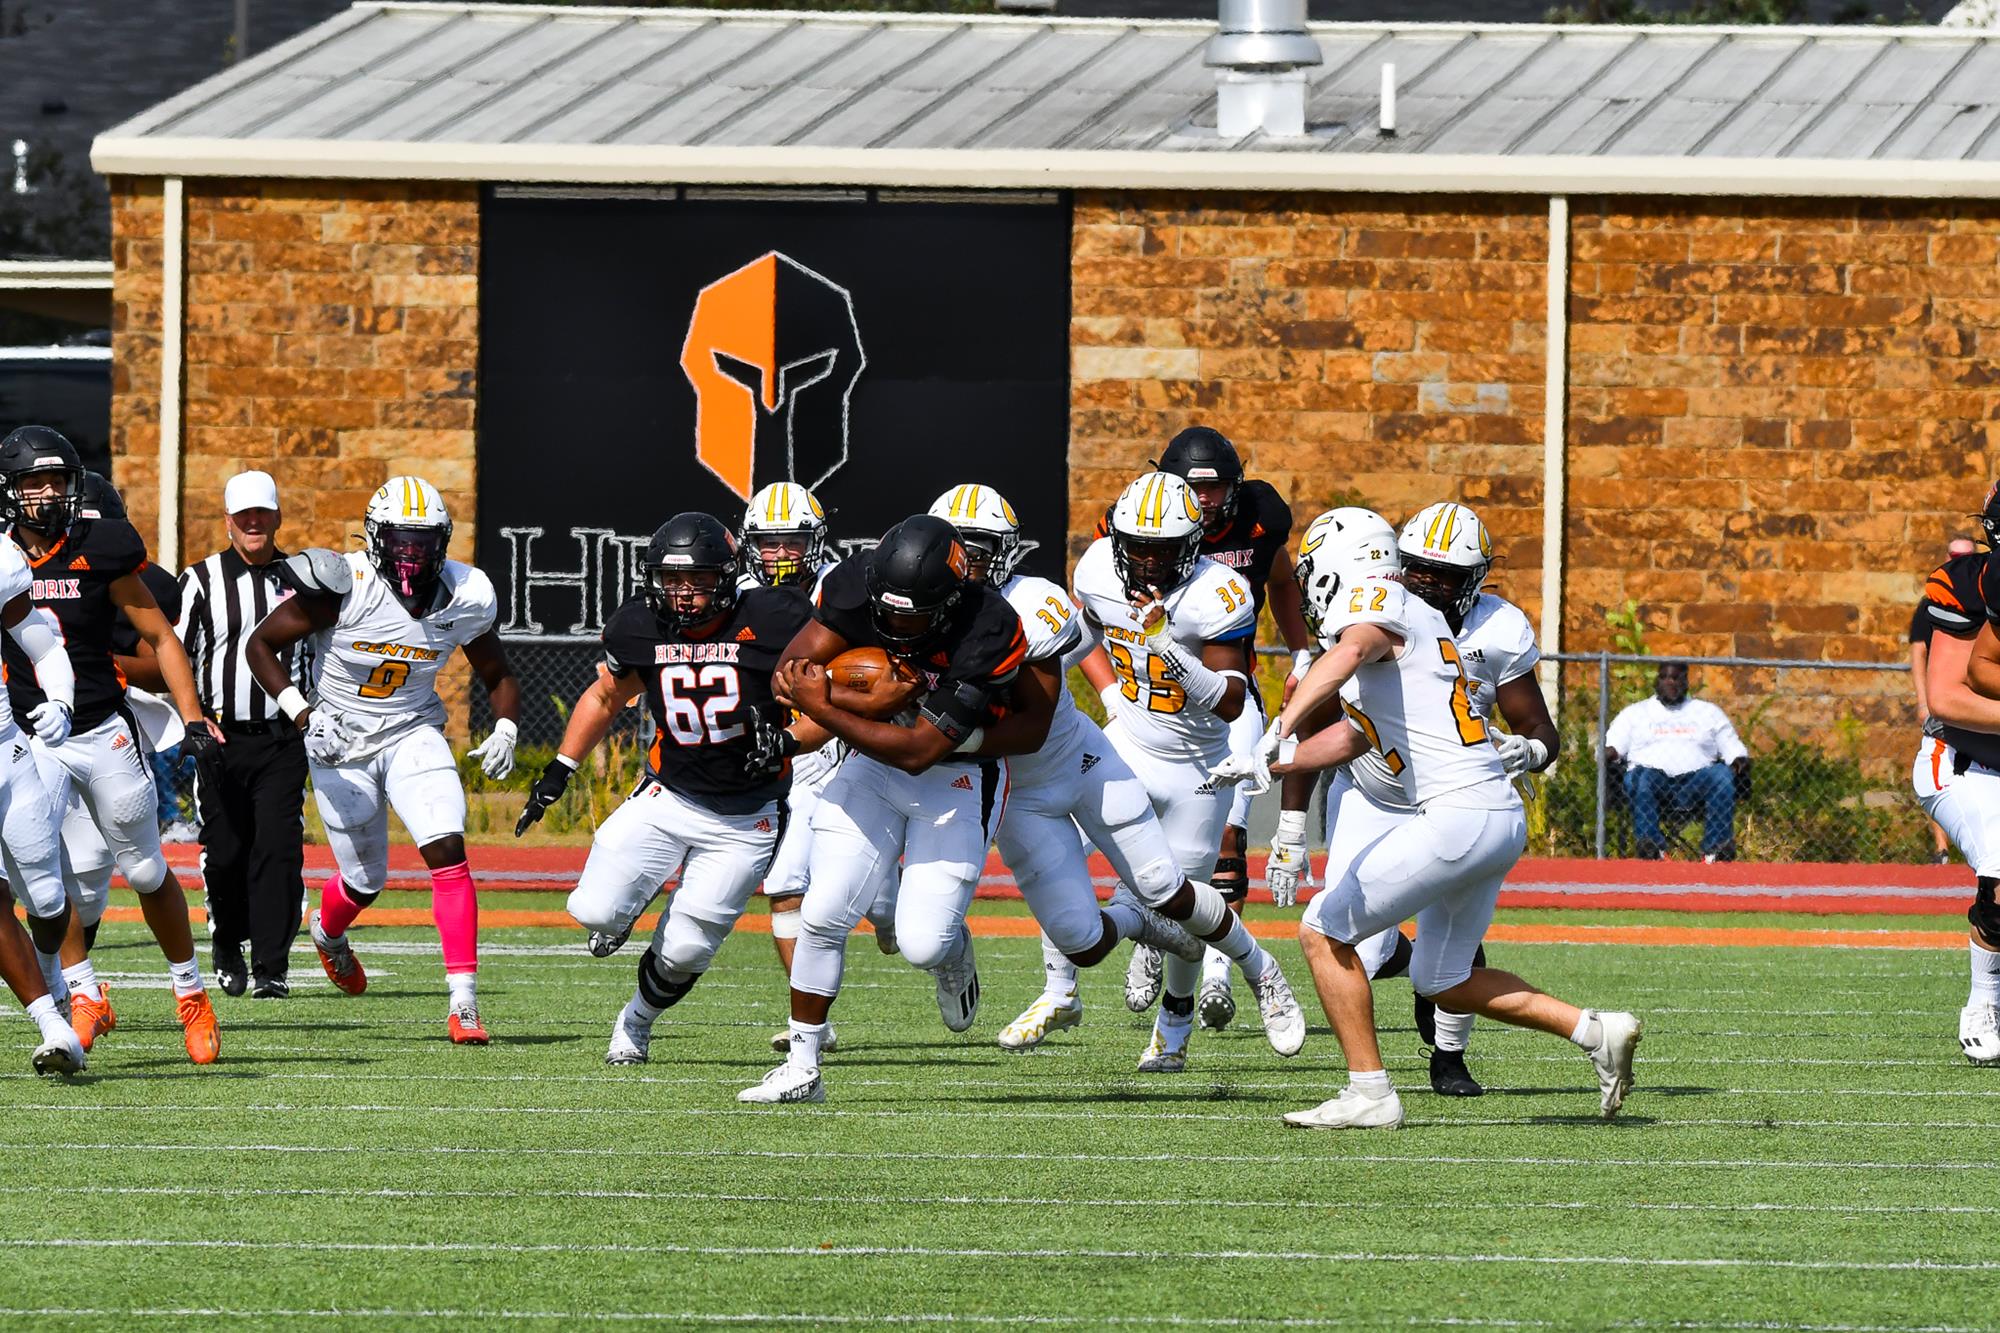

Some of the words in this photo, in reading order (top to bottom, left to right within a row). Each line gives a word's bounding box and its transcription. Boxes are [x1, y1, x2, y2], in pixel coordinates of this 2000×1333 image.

[1205, 548, 1255, 569] DRIX
[1370, 549, 1381, 560] 22
[29, 578, 82, 601] DRIX
[1215, 578, 1247, 614] 35
[1349, 586, 1388, 613] 22
[1036, 595, 1071, 635] 32
[1103, 625, 1148, 647] CENT
[351, 640, 443, 661] CENTRE
[654, 642, 741, 665] HENDRIX
[660, 663, 747, 746] 62
